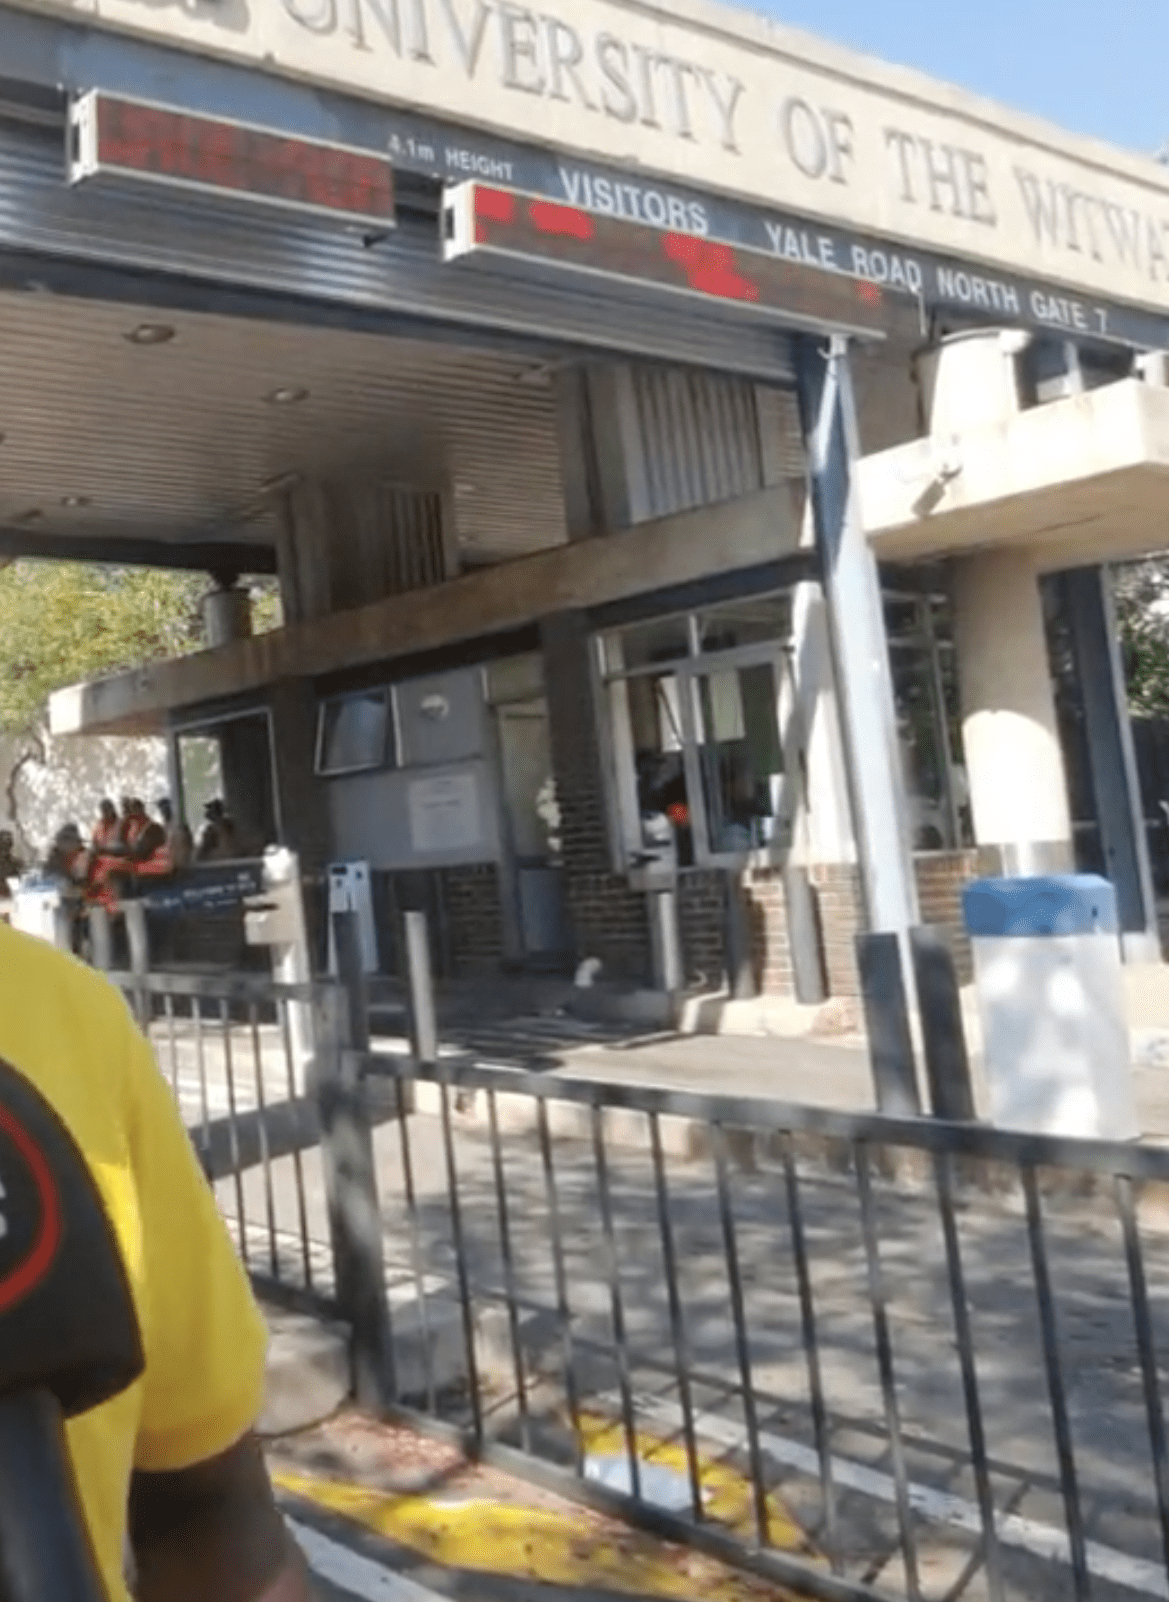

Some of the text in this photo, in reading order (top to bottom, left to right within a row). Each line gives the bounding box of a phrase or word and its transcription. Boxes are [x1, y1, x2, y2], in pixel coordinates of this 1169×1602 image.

[445, 147, 513, 181] HEIGHT
[559, 166, 709, 237] VISITORS
[783, 96, 855, 184] OF
[884, 126, 998, 229] THE
[765, 220, 838, 271] YALE
[851, 244, 922, 294] ROAD
[936, 266, 1020, 315] NORTH
[1031, 289, 1088, 328] GATE
[1094, 307, 1108, 335] 7
